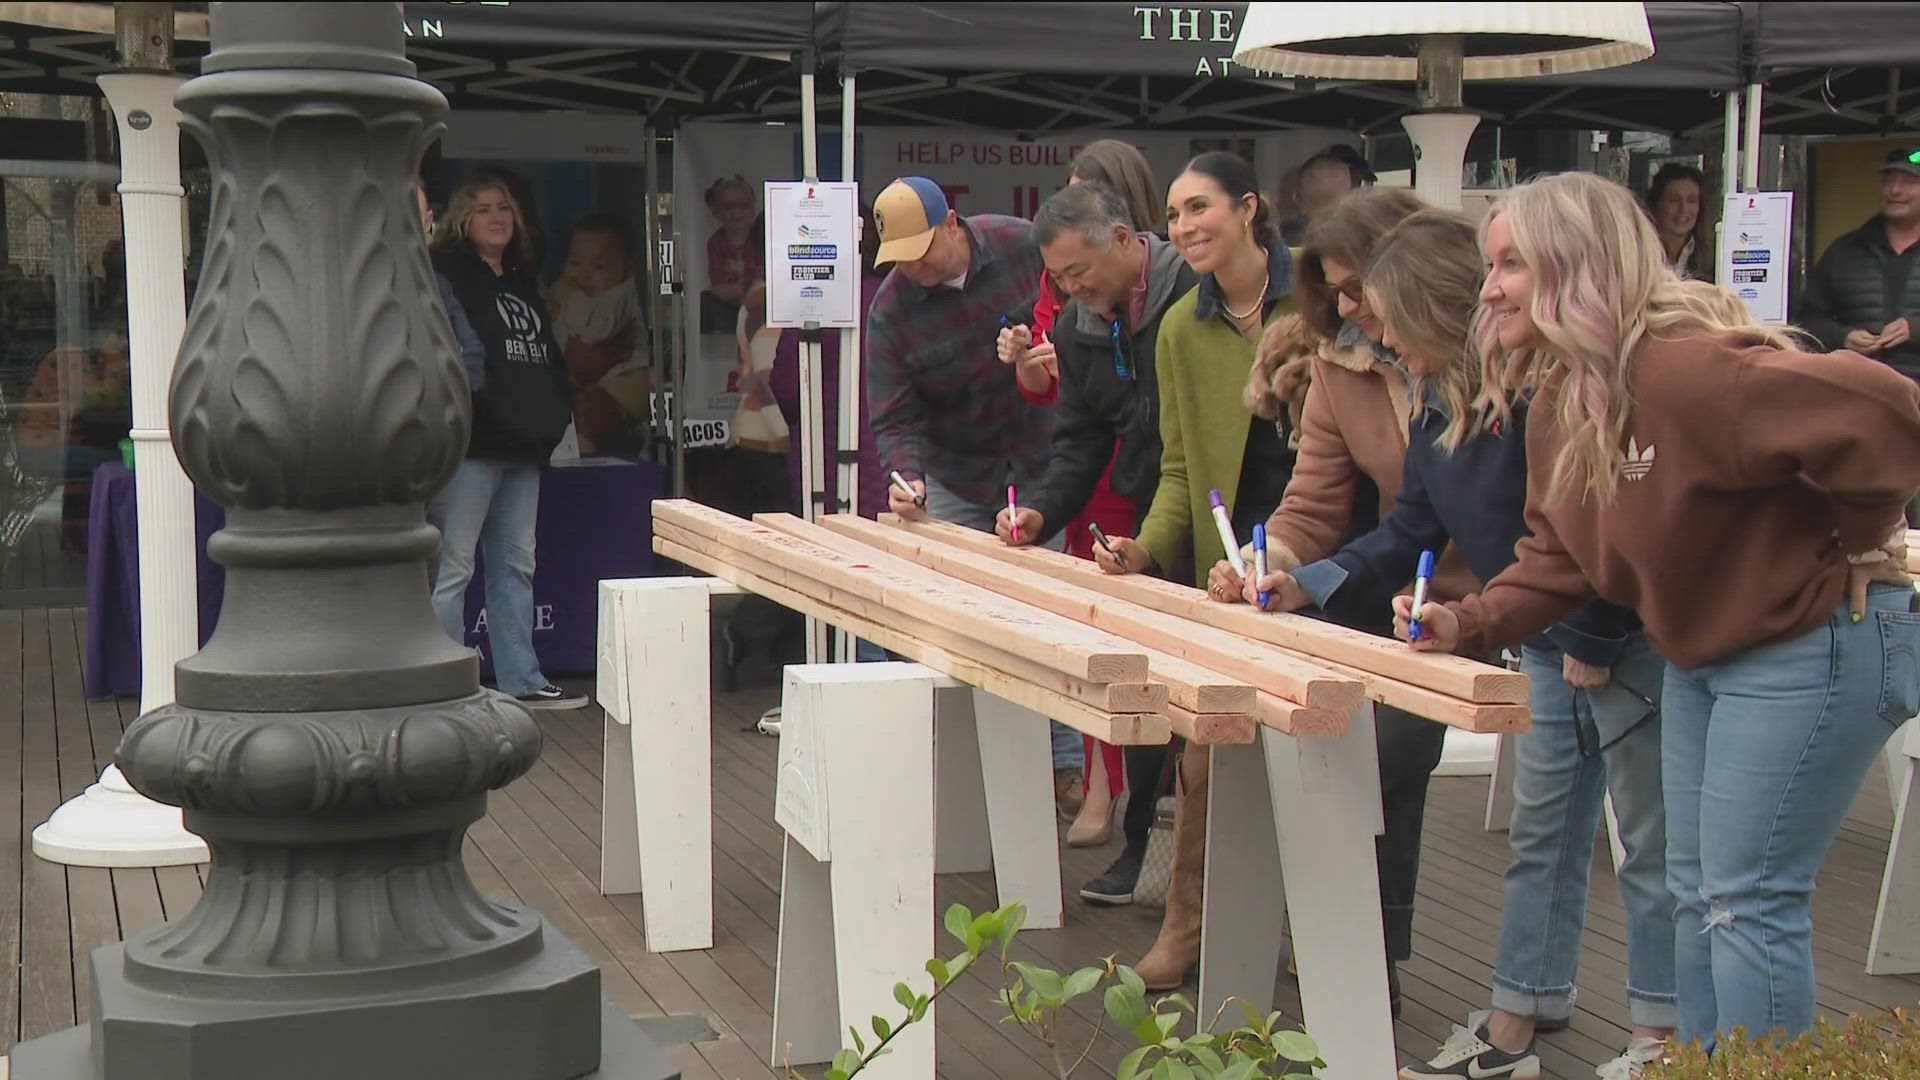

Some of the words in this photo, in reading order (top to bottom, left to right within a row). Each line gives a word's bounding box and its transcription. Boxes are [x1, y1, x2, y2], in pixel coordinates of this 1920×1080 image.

[1134, 6, 1235, 42] THE
[1195, 56, 1232, 77] AT
[897, 143, 965, 164] HELP
[972, 145, 1001, 166] US
